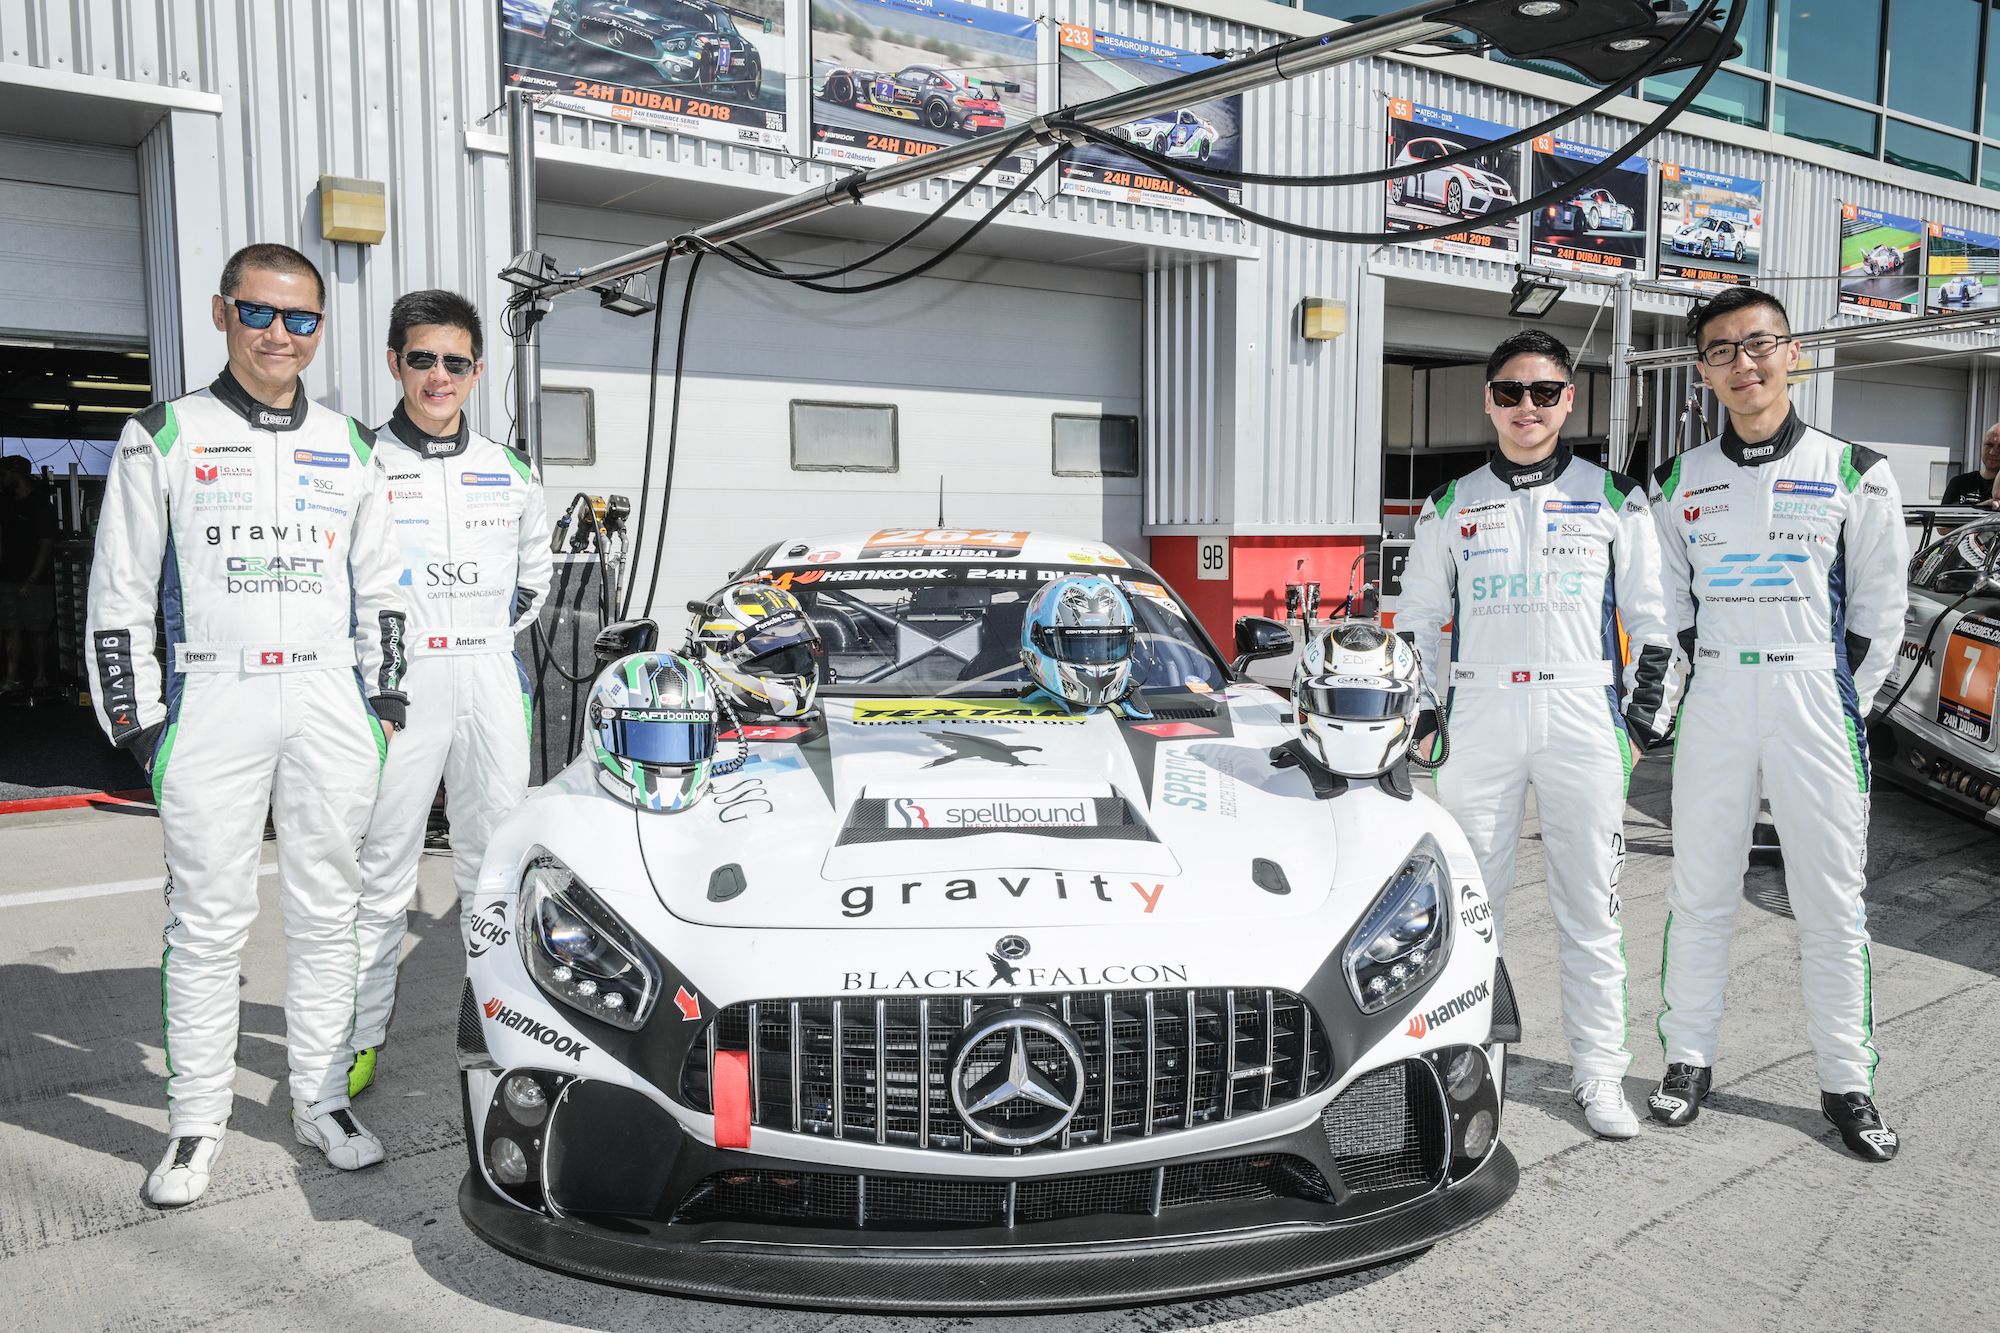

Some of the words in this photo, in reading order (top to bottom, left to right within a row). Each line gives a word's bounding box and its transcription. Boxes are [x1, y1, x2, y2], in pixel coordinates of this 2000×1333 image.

[1065, 28, 1089, 46] 233
[1104, 36, 1149, 54] BESAGROUP
[1150, 46, 1177, 59] RACING
[881, 84, 888, 95] 2
[574, 81, 615, 101] 24H
[621, 89, 681, 112] DUBAI
[687, 101, 731, 120] 2018
[1395, 103, 1407, 116] 55
[1420, 108, 1438, 118] ATECH
[866, 135, 900, 152] 24H
[1538, 137, 1549, 150] 63
[1666, 165, 1675, 177] 67
[1103, 171, 1130, 187] 24H
[1134, 176, 1174, 193] DUBAI
[1469, 234, 1491, 247] 2018
[1557, 248, 1574, 259] 24H
[1576, 250, 1601, 264] DUBAI
[1602, 256, 1622, 266] 2018
[1681, 267, 1697, 279] 24H
[1698, 270, 1720, 281] DUBAI
[259, 411, 291, 425] freem
[122, 444, 153, 460] freem
[427, 441, 456, 454] freem
[1743, 446, 1773, 460] freem
[313, 479, 334, 491] SSG
[1512, 472, 1543, 485] freem
[1863, 482, 1888, 496] freem
[1627, 502, 1649, 516] freem
[465, 519, 512, 529] gravity
[1561, 524, 1581, 533] SSG
[206, 522, 336, 549] gravity
[874, 530, 1017, 544] 264
[1699, 533, 1717, 543] SSG
[1769, 531, 1826, 544] gravity
[880, 549, 924, 558] 24H
[930, 549, 998, 557] DUBAI
[1203, 545, 1223, 569] 9B
[1542, 546, 1595, 556] gravity
[226, 556, 323, 574] CRAFT
[426, 562, 479, 587] SSG
[967, 569, 1027, 580] 24H
[227, 576, 323, 594] bamboo
[427, 592, 458, 600] CAPITAL
[458, 589, 506, 599] MANAGEMENT
[1472, 604, 1511, 616] REACH
[1514, 603, 1549, 614] YOUR
[1552, 601, 1583, 612] BEST
[755, 617, 782, 631] Porsche
[781, 612, 796, 620] Club
[456, 636, 487, 646] Antares
[185, 651, 217, 663] freem
[292, 652, 318, 662] Frank
[1699, 647, 1720, 659] freem
[1767, 653, 1794, 662] Kevin
[1455, 668, 1475, 679] freem
[1539, 671, 1554, 681] Jon
[1960, 645, 1982, 698] 7
[102, 636, 131, 726] gravity
[1943, 712, 1958, 729] 24H
[1960, 716, 1983, 739] DUBAI
[712, 778, 773, 823] SSG
[946, 802, 1086, 828] spellbound
[841, 871, 1165, 917] gravity
[1461, 901, 1493, 927] FUCHS
[470, 913, 511, 947] FUCHS
[842, 968, 980, 990] BLACK
[1026, 964, 1189, 988] FALCON
